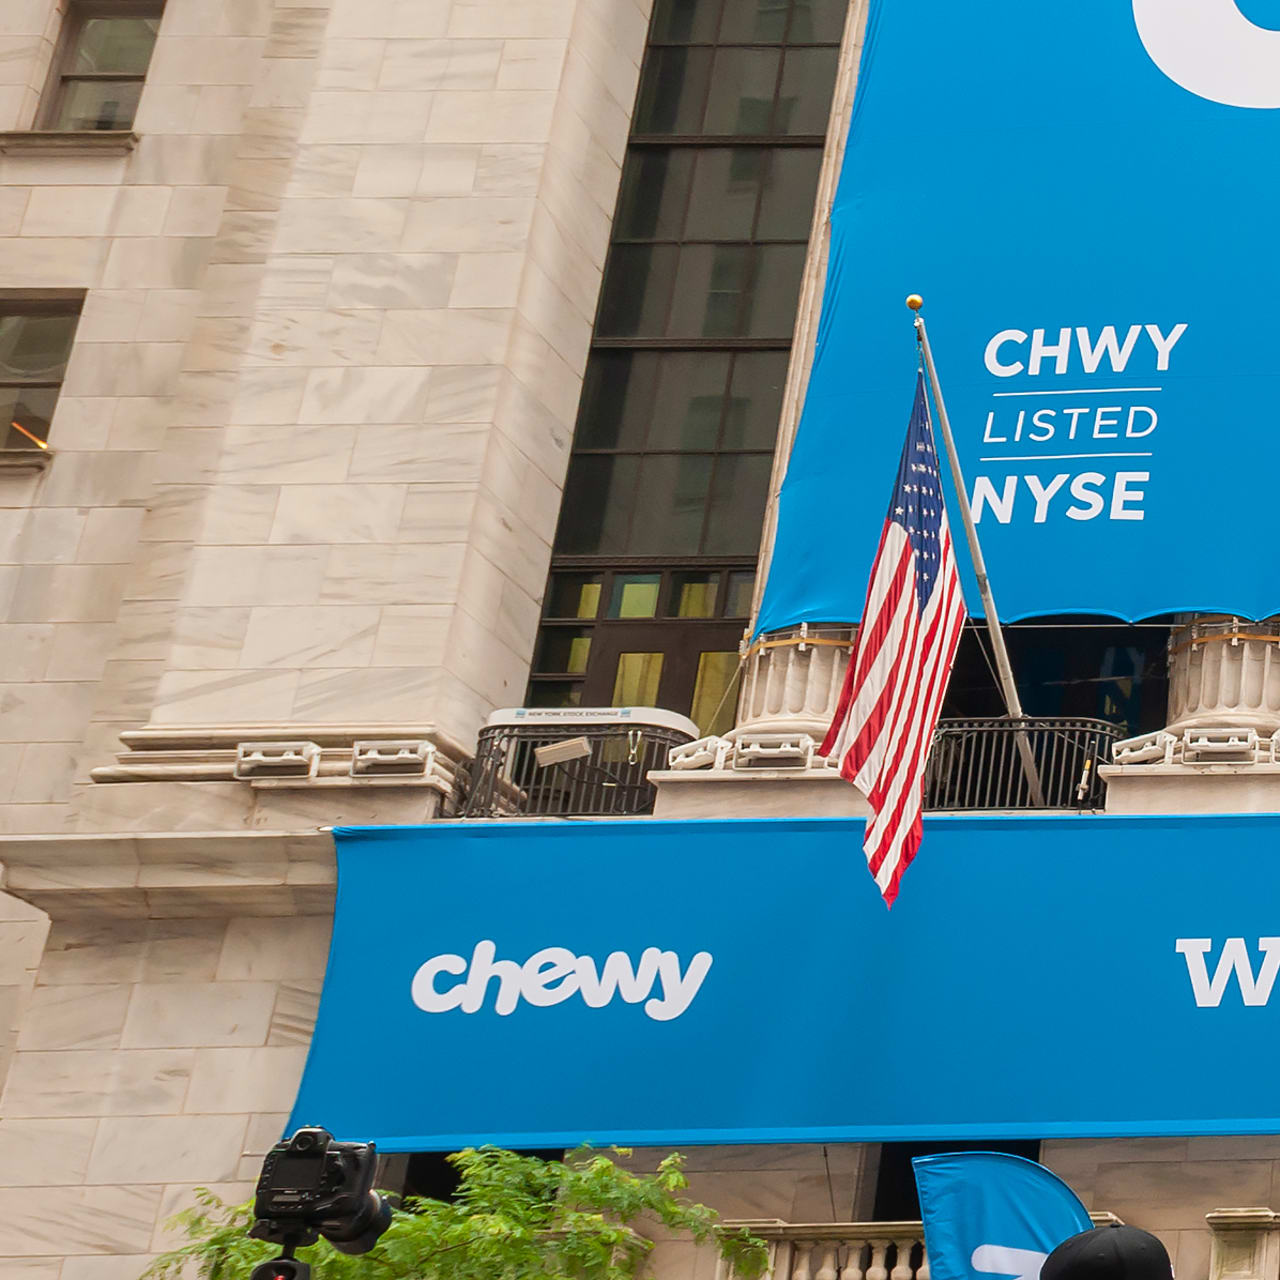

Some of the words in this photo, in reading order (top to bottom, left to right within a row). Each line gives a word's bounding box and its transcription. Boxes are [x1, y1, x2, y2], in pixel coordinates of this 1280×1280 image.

[983, 323, 1188, 377] CHWY
[983, 406, 1158, 443] LISTED
[971, 471, 1150, 524] NYSE
[411, 939, 713, 1021] chewy
